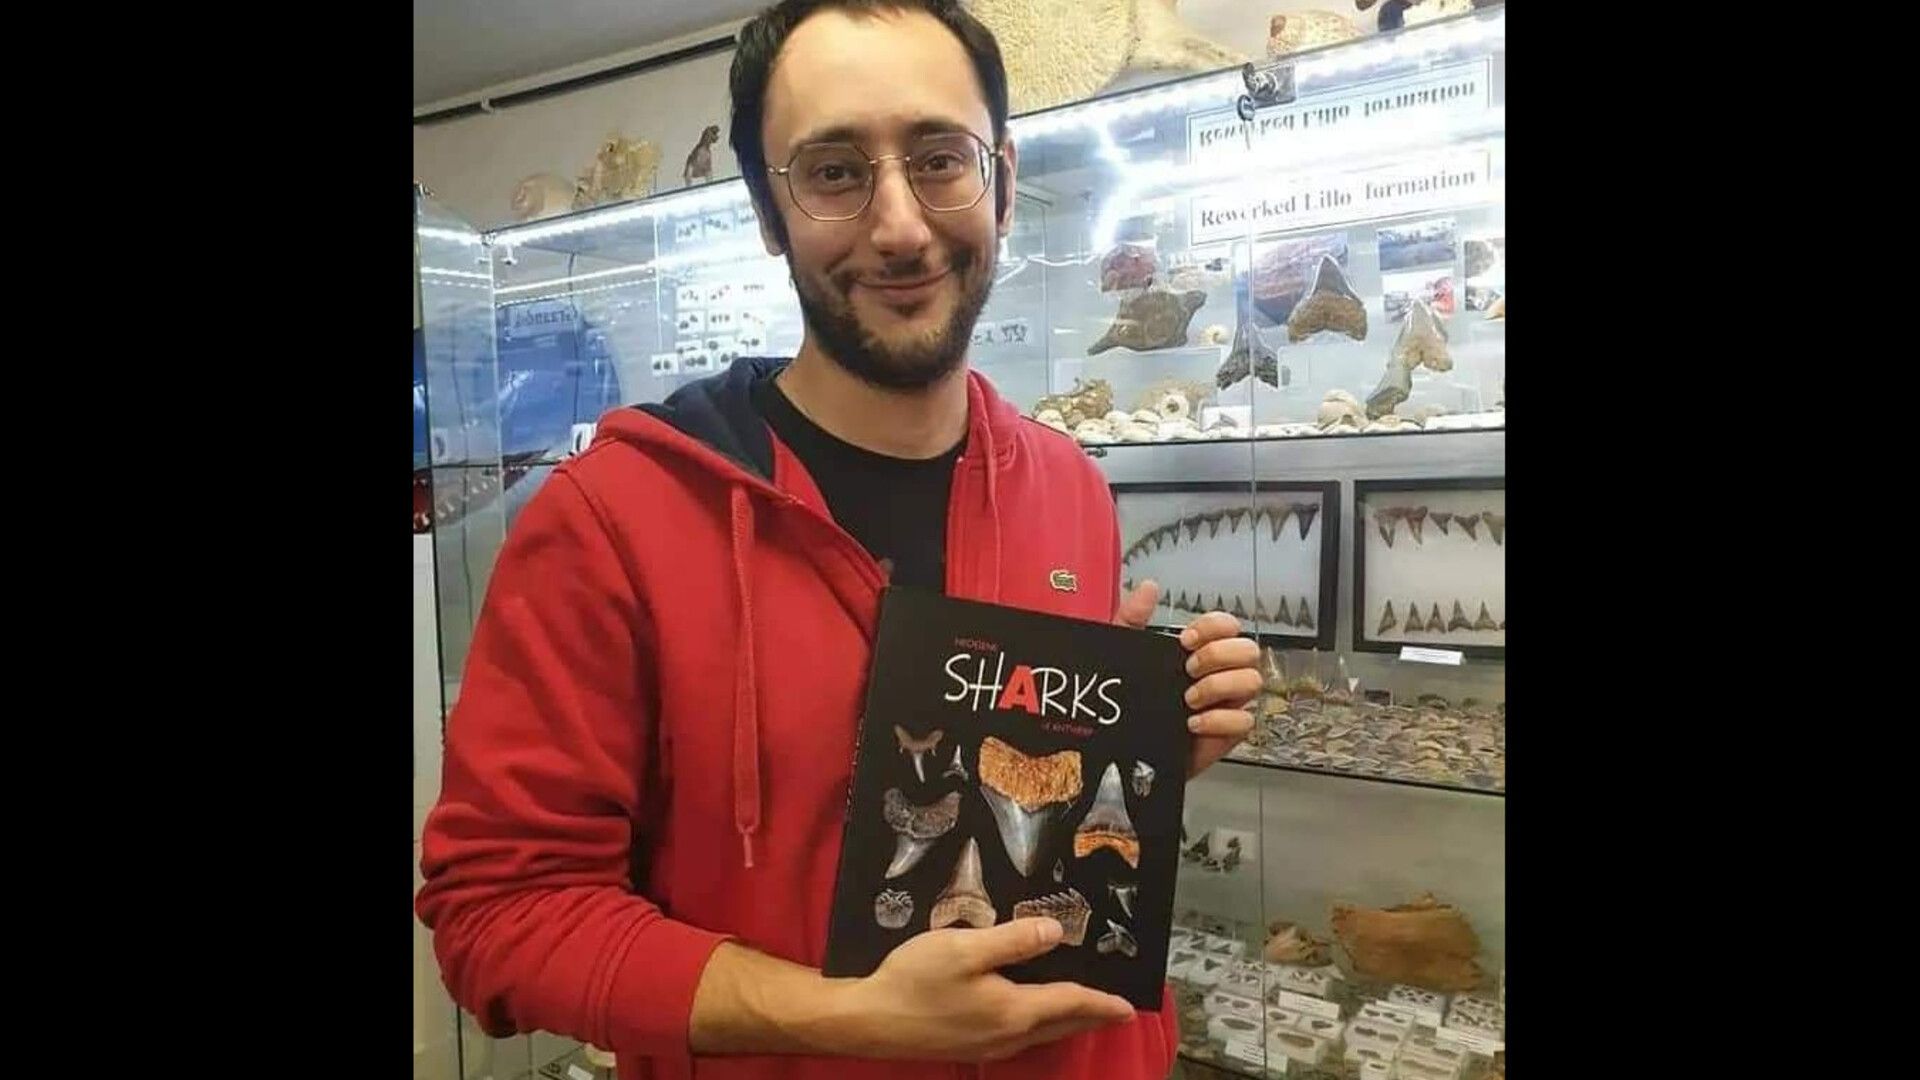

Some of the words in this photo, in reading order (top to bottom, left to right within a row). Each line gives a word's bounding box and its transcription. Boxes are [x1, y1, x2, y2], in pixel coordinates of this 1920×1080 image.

[1305, 189, 1352, 211] Lillo
[1366, 169, 1476, 200] formation
[944, 651, 1122, 725] SHARKS
